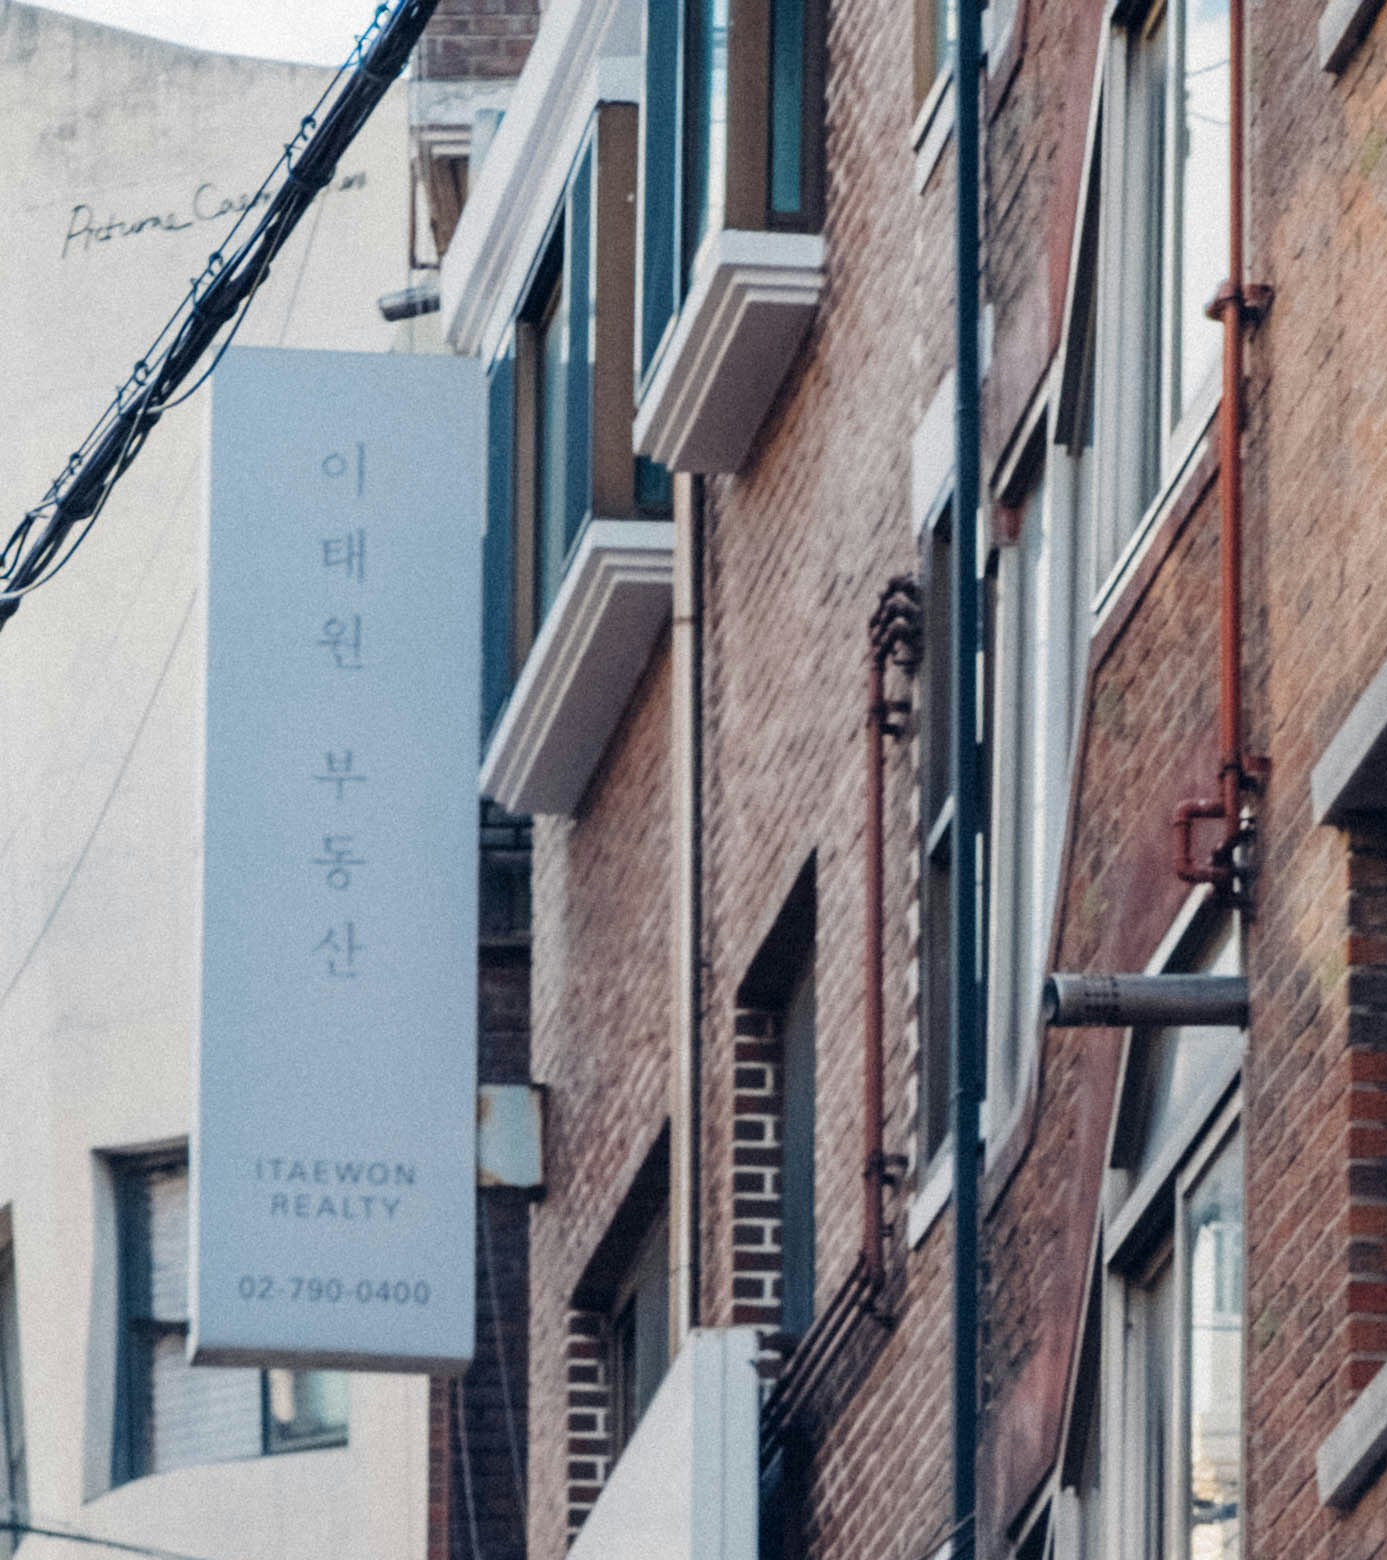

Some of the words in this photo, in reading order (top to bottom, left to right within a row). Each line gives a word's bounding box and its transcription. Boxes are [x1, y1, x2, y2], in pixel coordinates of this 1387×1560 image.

[255, 1158, 416, 1186] ITAEWON
[270, 1193, 401, 1220] REALTY
[238, 1275, 432, 1305] 02-790-0400
